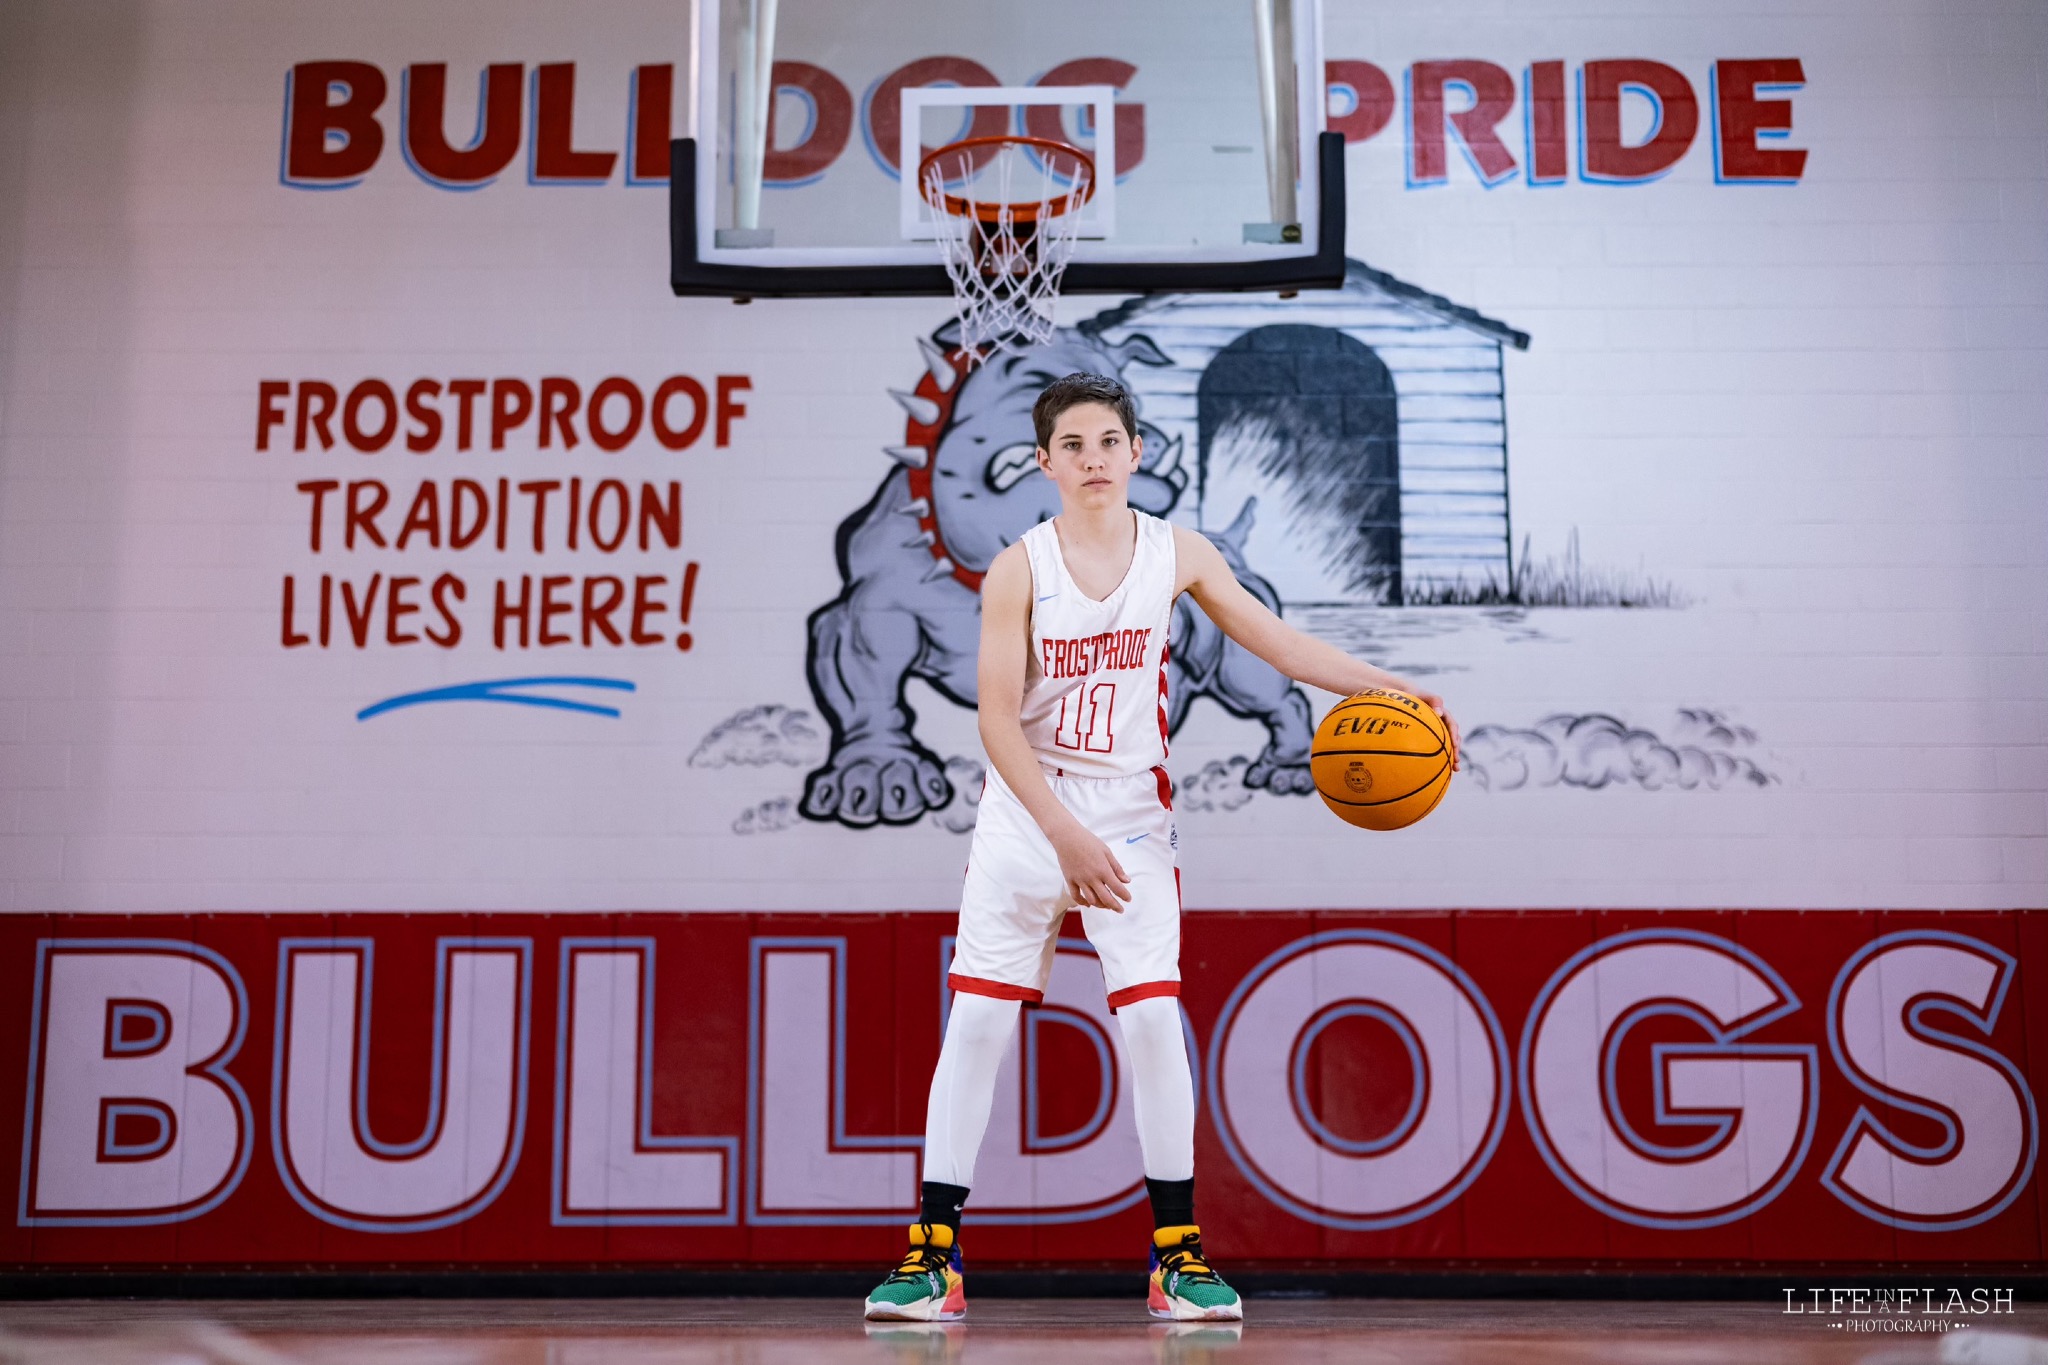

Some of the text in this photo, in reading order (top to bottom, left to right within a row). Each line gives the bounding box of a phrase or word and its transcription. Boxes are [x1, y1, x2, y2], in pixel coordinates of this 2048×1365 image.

[1300, 58, 1808, 188] PRIDE
[256, 375, 753, 454] FROSTPROOF
[297, 477, 682, 554] TRADITION
[281, 562, 701, 652] LIVES HERE!
[1041, 628, 1152, 679] FROSTPROOF
[1054, 682, 1116, 754] 11
[1334, 717, 1411, 737] EVO NXT
[17, 928, 2039, 1232] BULLDOGS
